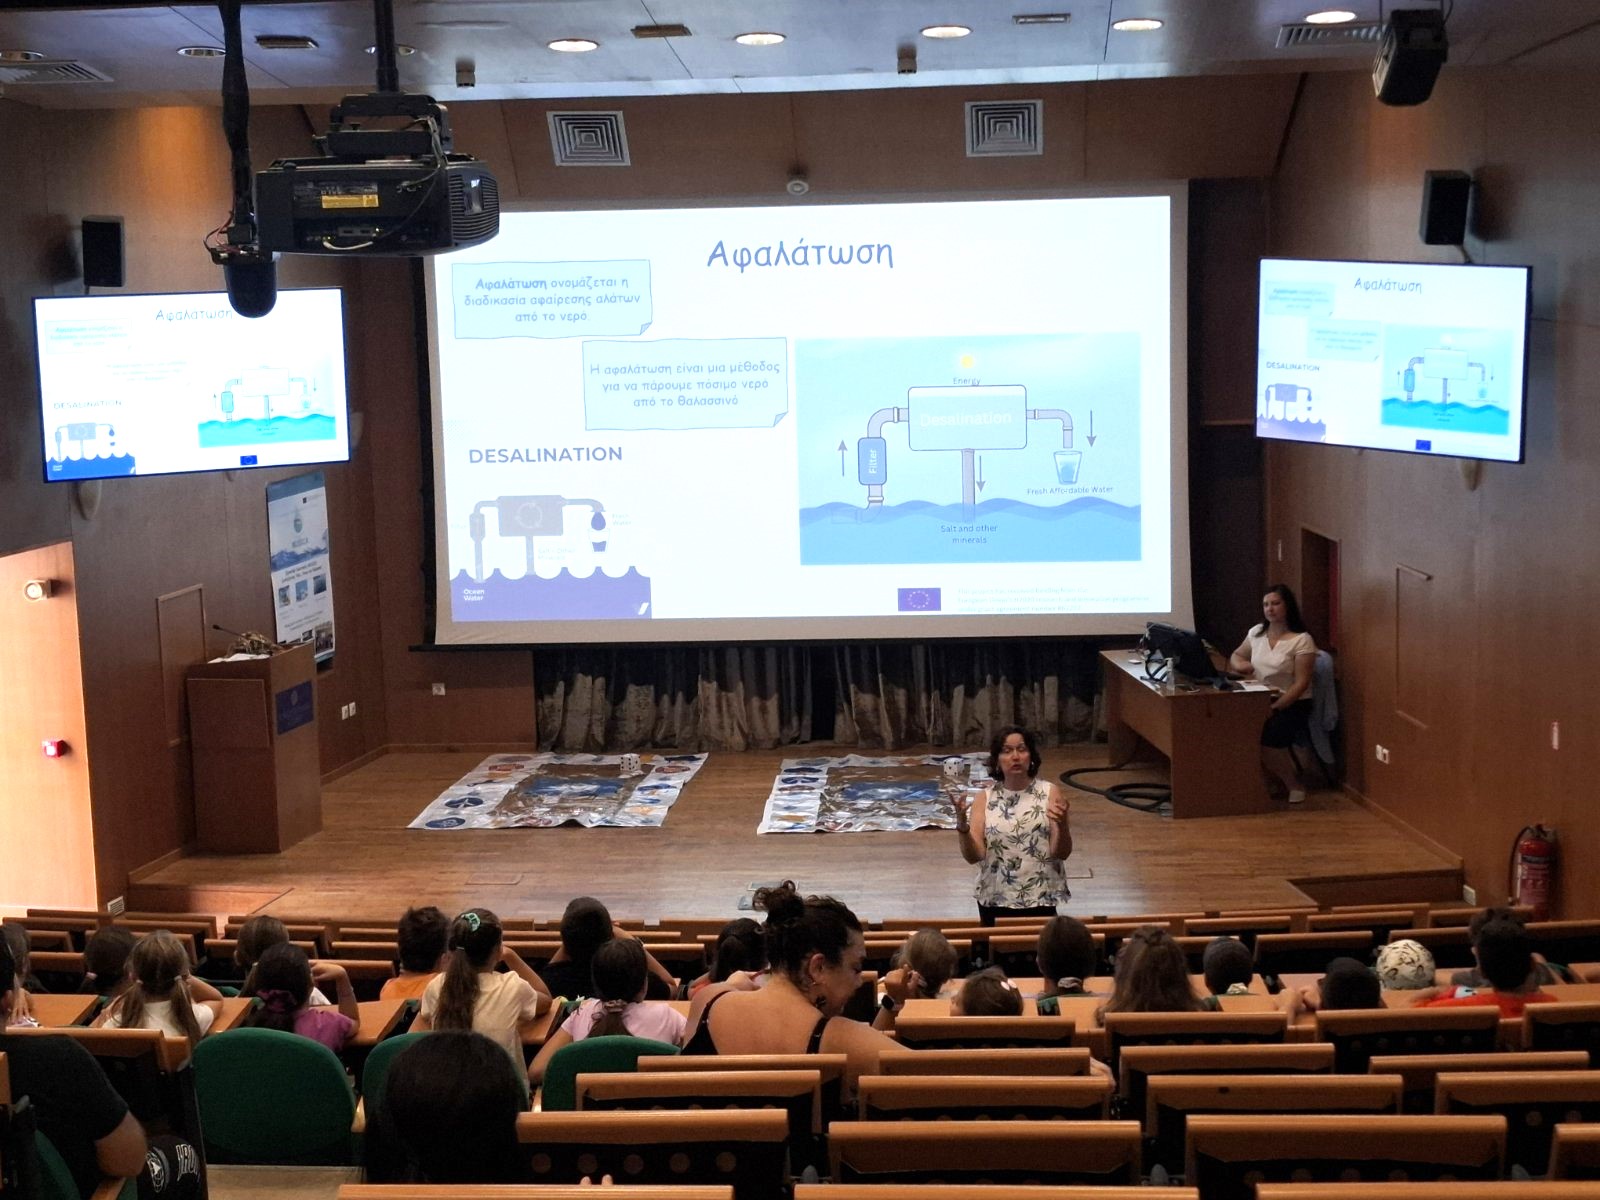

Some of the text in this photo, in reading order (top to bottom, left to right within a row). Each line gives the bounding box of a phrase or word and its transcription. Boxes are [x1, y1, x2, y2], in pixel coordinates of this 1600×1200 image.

[707, 238, 894, 273] Αφαλάτωση
[475, 276, 629, 291] Αφαλάτωση ονομάζεται η
[464, 293, 641, 306] διαδικασία αφαίρεσης αλάτων
[515, 312, 538, 322] από
[543, 314, 556, 322] το
[590, 360, 780, 376] Η αφαλάτωση είναι μια μέθοδος
[602, 379, 769, 393] για να πάρουμε πόσιμο νερό
[952, 376, 981, 386] Energy
[633, 395, 739, 407] από το θαλασσινό
[920, 409, 1012, 427] Desalination
[469, 447, 623, 463] DESALINATION
[869, 449, 878, 474] Filter
[1027, 485, 1114, 495] Fresh Affordable Water
[941, 523, 998, 533] Salt and other
[952, 535, 987, 544] minerals
